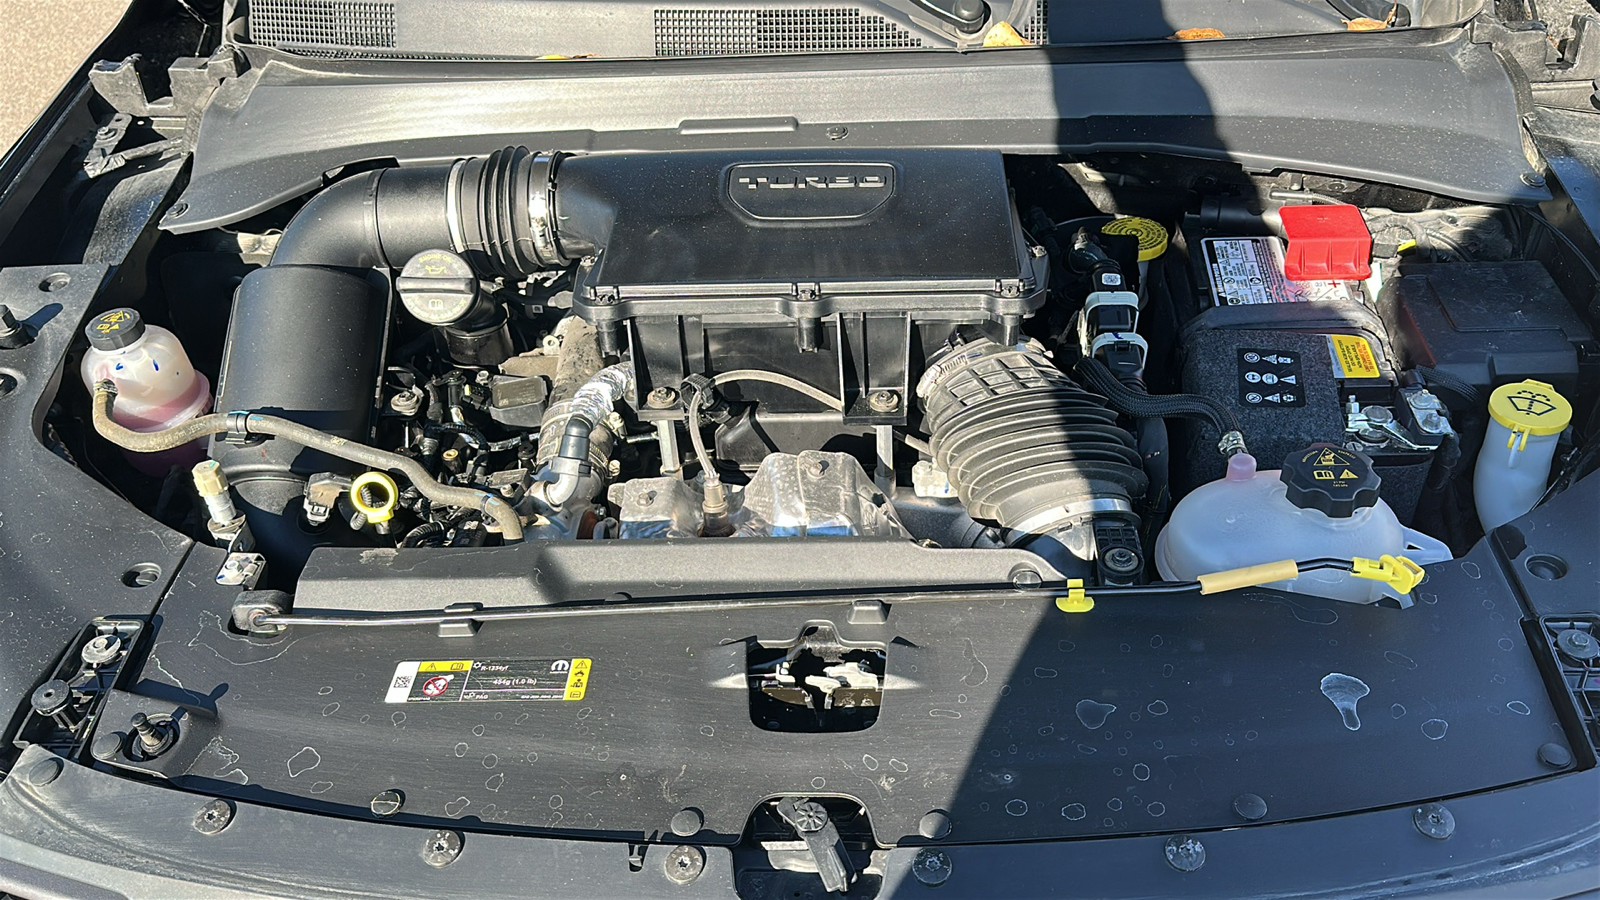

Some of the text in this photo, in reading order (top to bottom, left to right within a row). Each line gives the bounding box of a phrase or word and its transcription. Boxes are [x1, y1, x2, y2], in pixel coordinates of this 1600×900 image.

[739, 176, 886, 189] TURBO
[419, 253, 453, 264] ENGINE OIL
[492, 678, 538, 686] 454g (1.0 lb)
